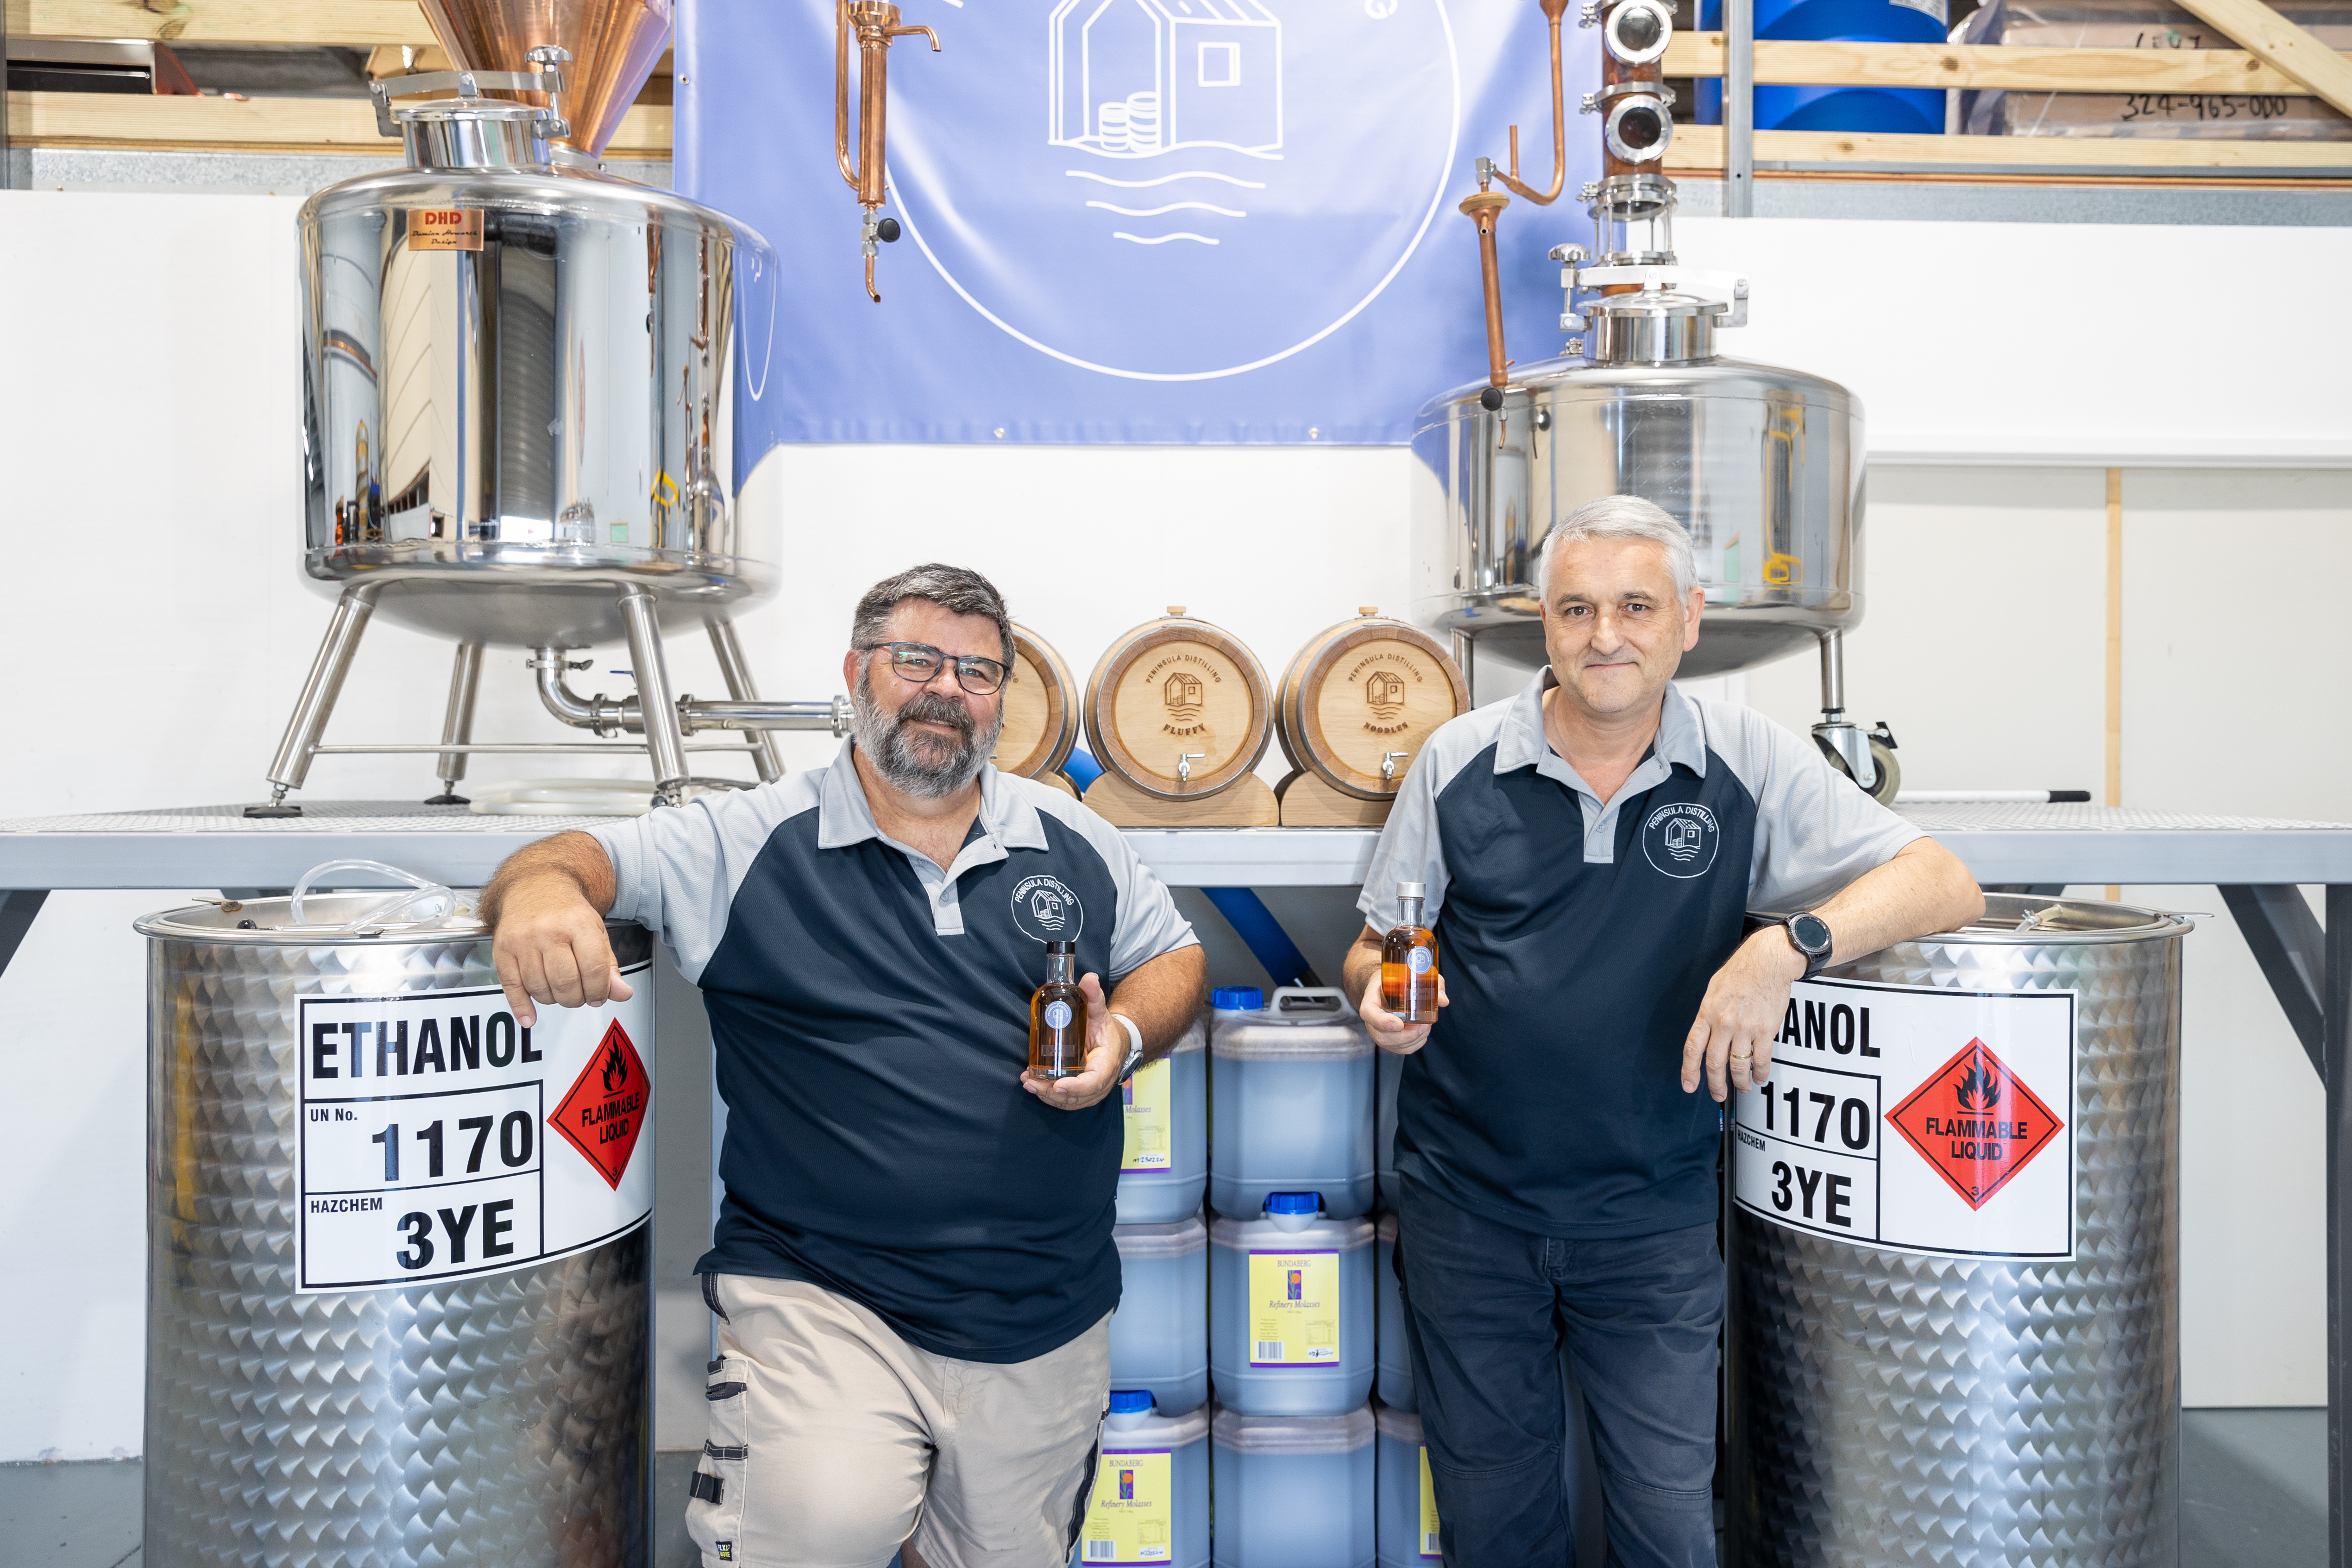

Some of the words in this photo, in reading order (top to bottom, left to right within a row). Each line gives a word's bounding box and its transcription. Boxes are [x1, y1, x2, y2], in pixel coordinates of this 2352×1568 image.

[425, 212, 462, 225] DHD
[1146, 655, 1181, 683] PENINSULA
[1185, 655, 1221, 683] DISTILLING
[1348, 654, 1384, 682] PENINSULA
[1387, 653, 1423, 682] DISTILLING
[1163, 723, 1207, 736] FLUFFY
[1364, 722, 1409, 734] NOODLES
[1648, 806, 1684, 830] PENINSULA
[1685, 806, 1715, 832] DISTILLING
[1015, 878, 1043, 903] PENINSULA
[1044, 878, 1075, 906] DISTILLING
[1773, 997, 1881, 1058] ANOL
[312, 1011, 542, 1079] ETHANOL
[310, 1109, 329, 1122] UN
[335, 1108, 358, 1121] No.
[582, 1092, 640, 1127] FLAMMABLE
[1761, 1081, 1870, 1151] 1170
[599, 1117, 629, 1145] LIQUID
[1737, 1129, 1766, 1152] HAZCHEM
[1926, 1117, 2028, 1140] FLAMMABLE
[371, 1110, 534, 1182] 1170
[1950, 1142, 2003, 1161] LIQUID
[612, 1166, 618, 1177] 3
[1771, 1160, 1852, 1228] 3YE
[1971, 1186, 1980, 1196] 3
[310, 1197, 383, 1214] HAZCHEM
[396, 1198, 514, 1270] 3YE
[1269, 1300, 1293, 1310] Refinery
[1101, 1499, 1124, 1510] Refinery
